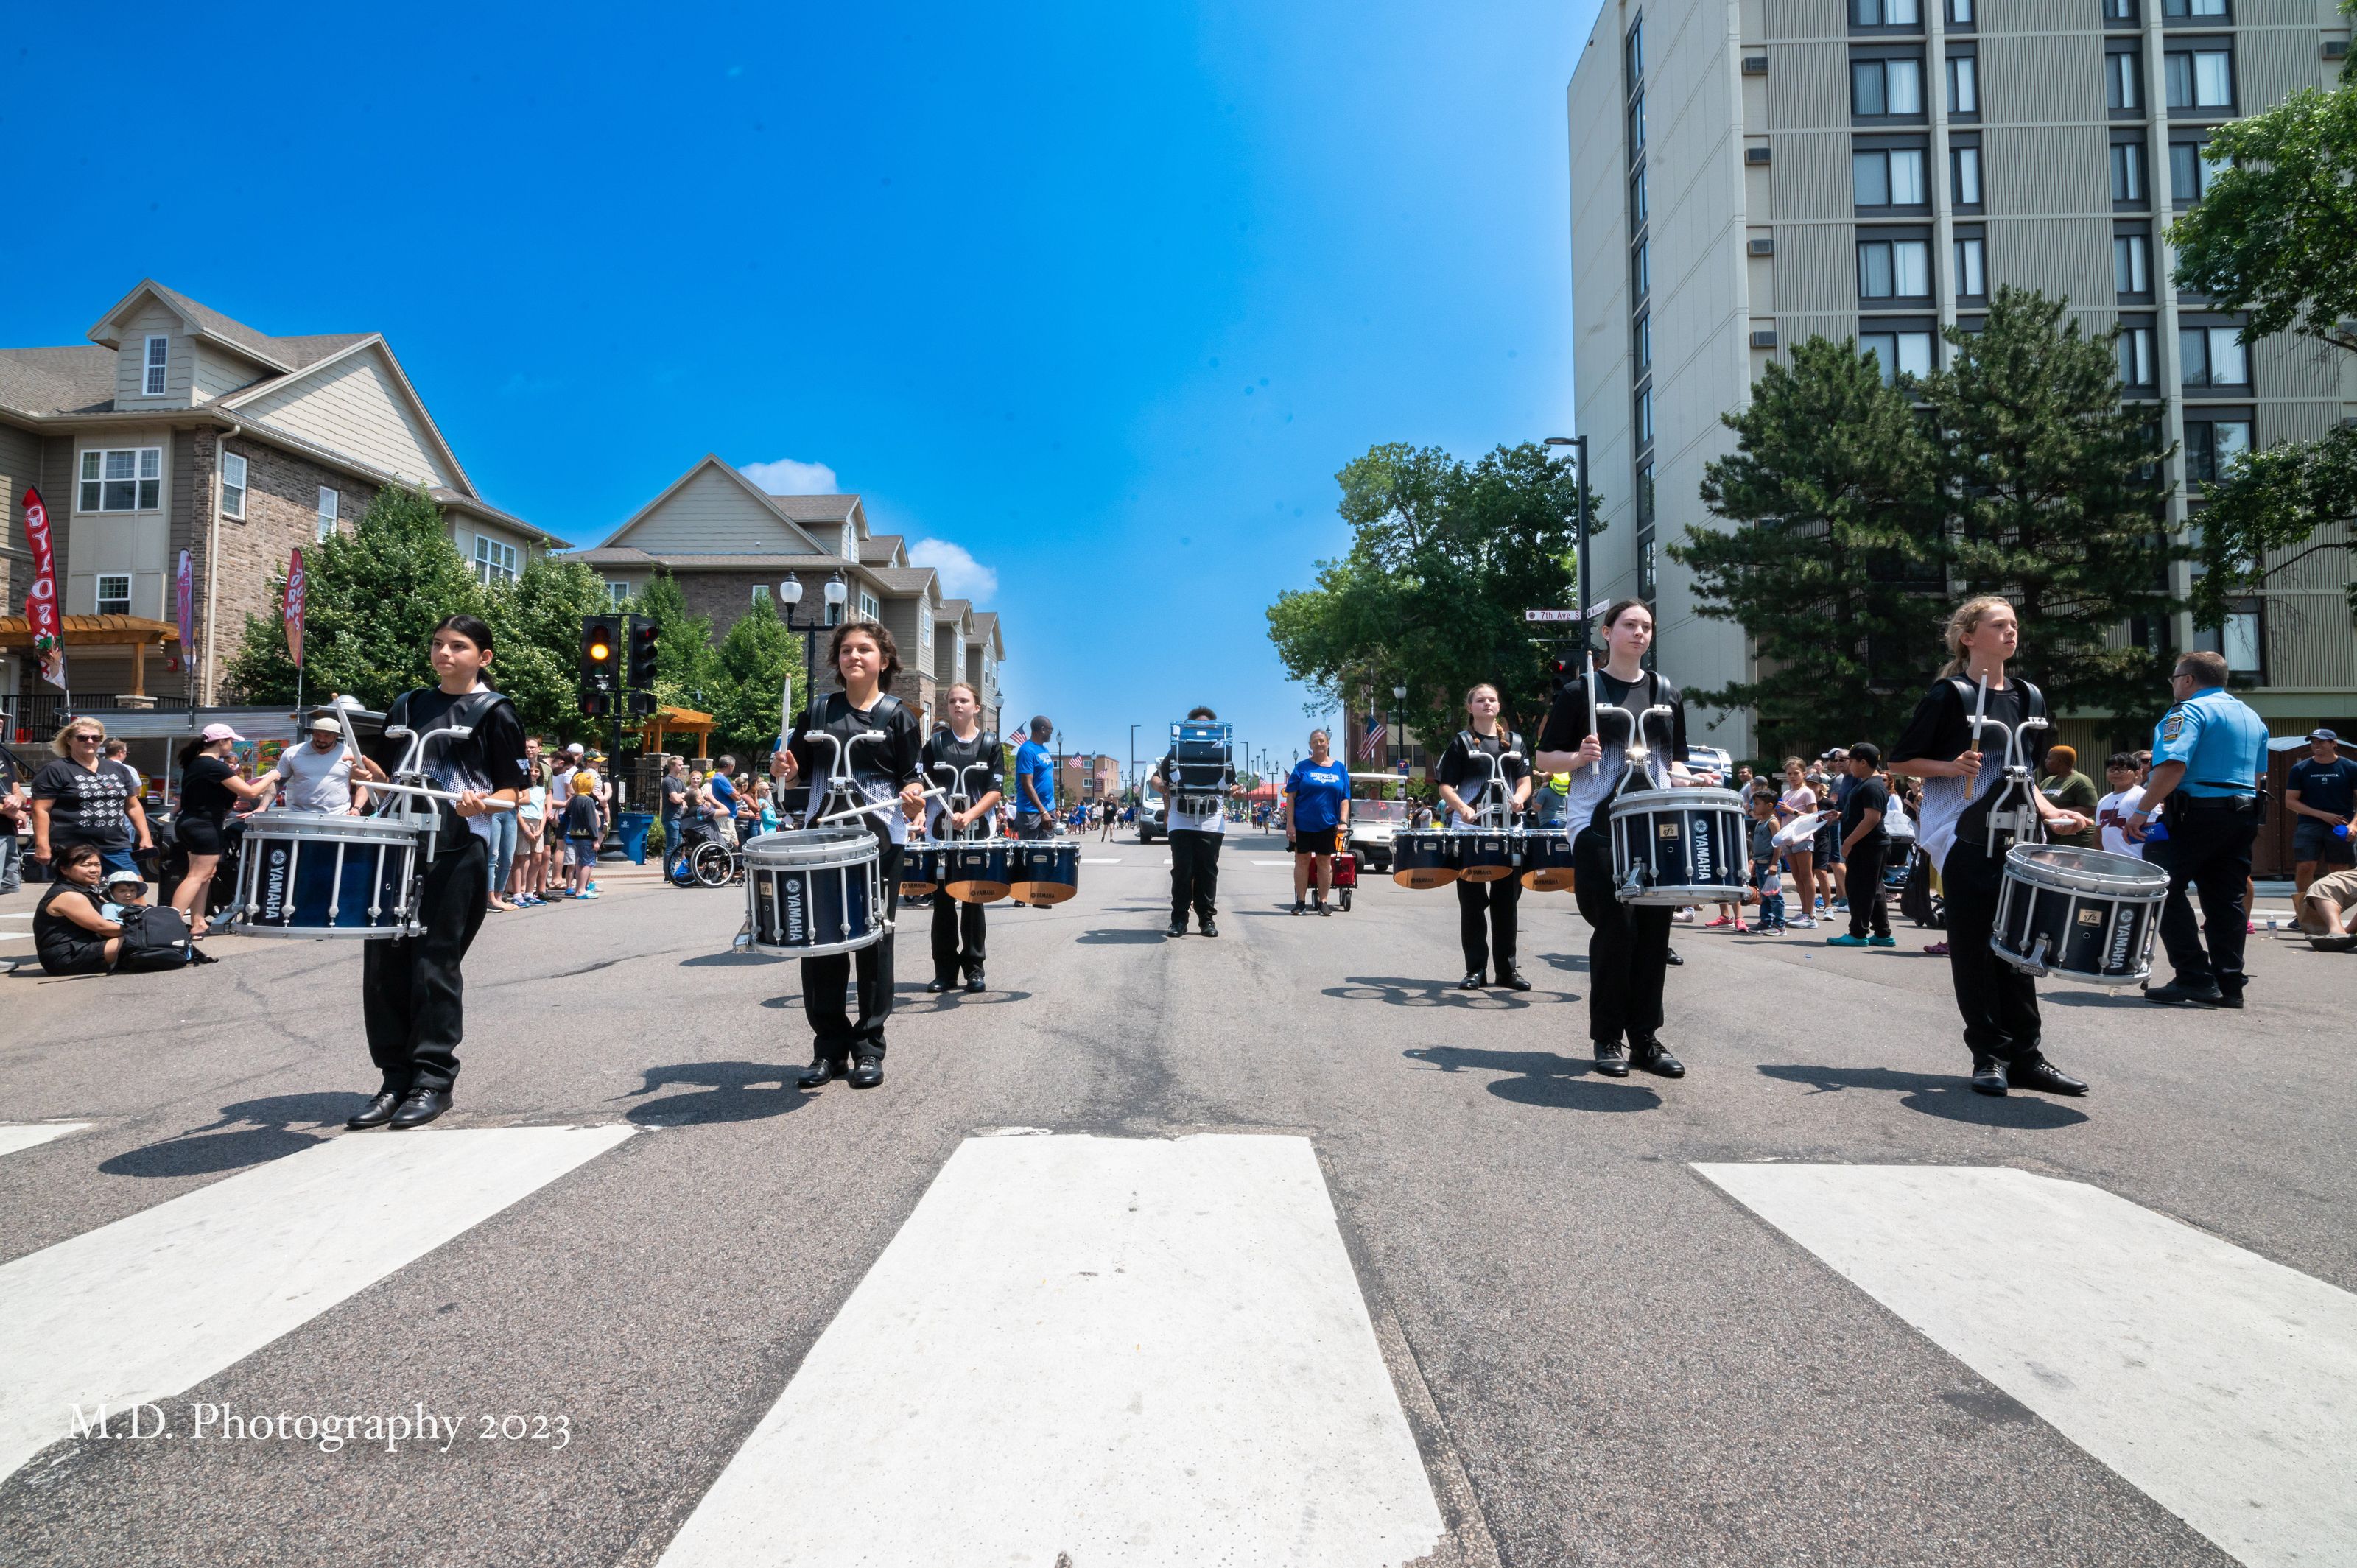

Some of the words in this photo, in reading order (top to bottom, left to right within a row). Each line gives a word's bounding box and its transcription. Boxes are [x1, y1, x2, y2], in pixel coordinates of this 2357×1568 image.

[1696, 834, 1711, 880] YAMAHA
[2004, 837, 2014, 845] M
[265, 866, 284, 919] YAMAHA
[787, 893, 803, 941] YAMAHA
[2110, 924, 2132, 969] YAMAHA
